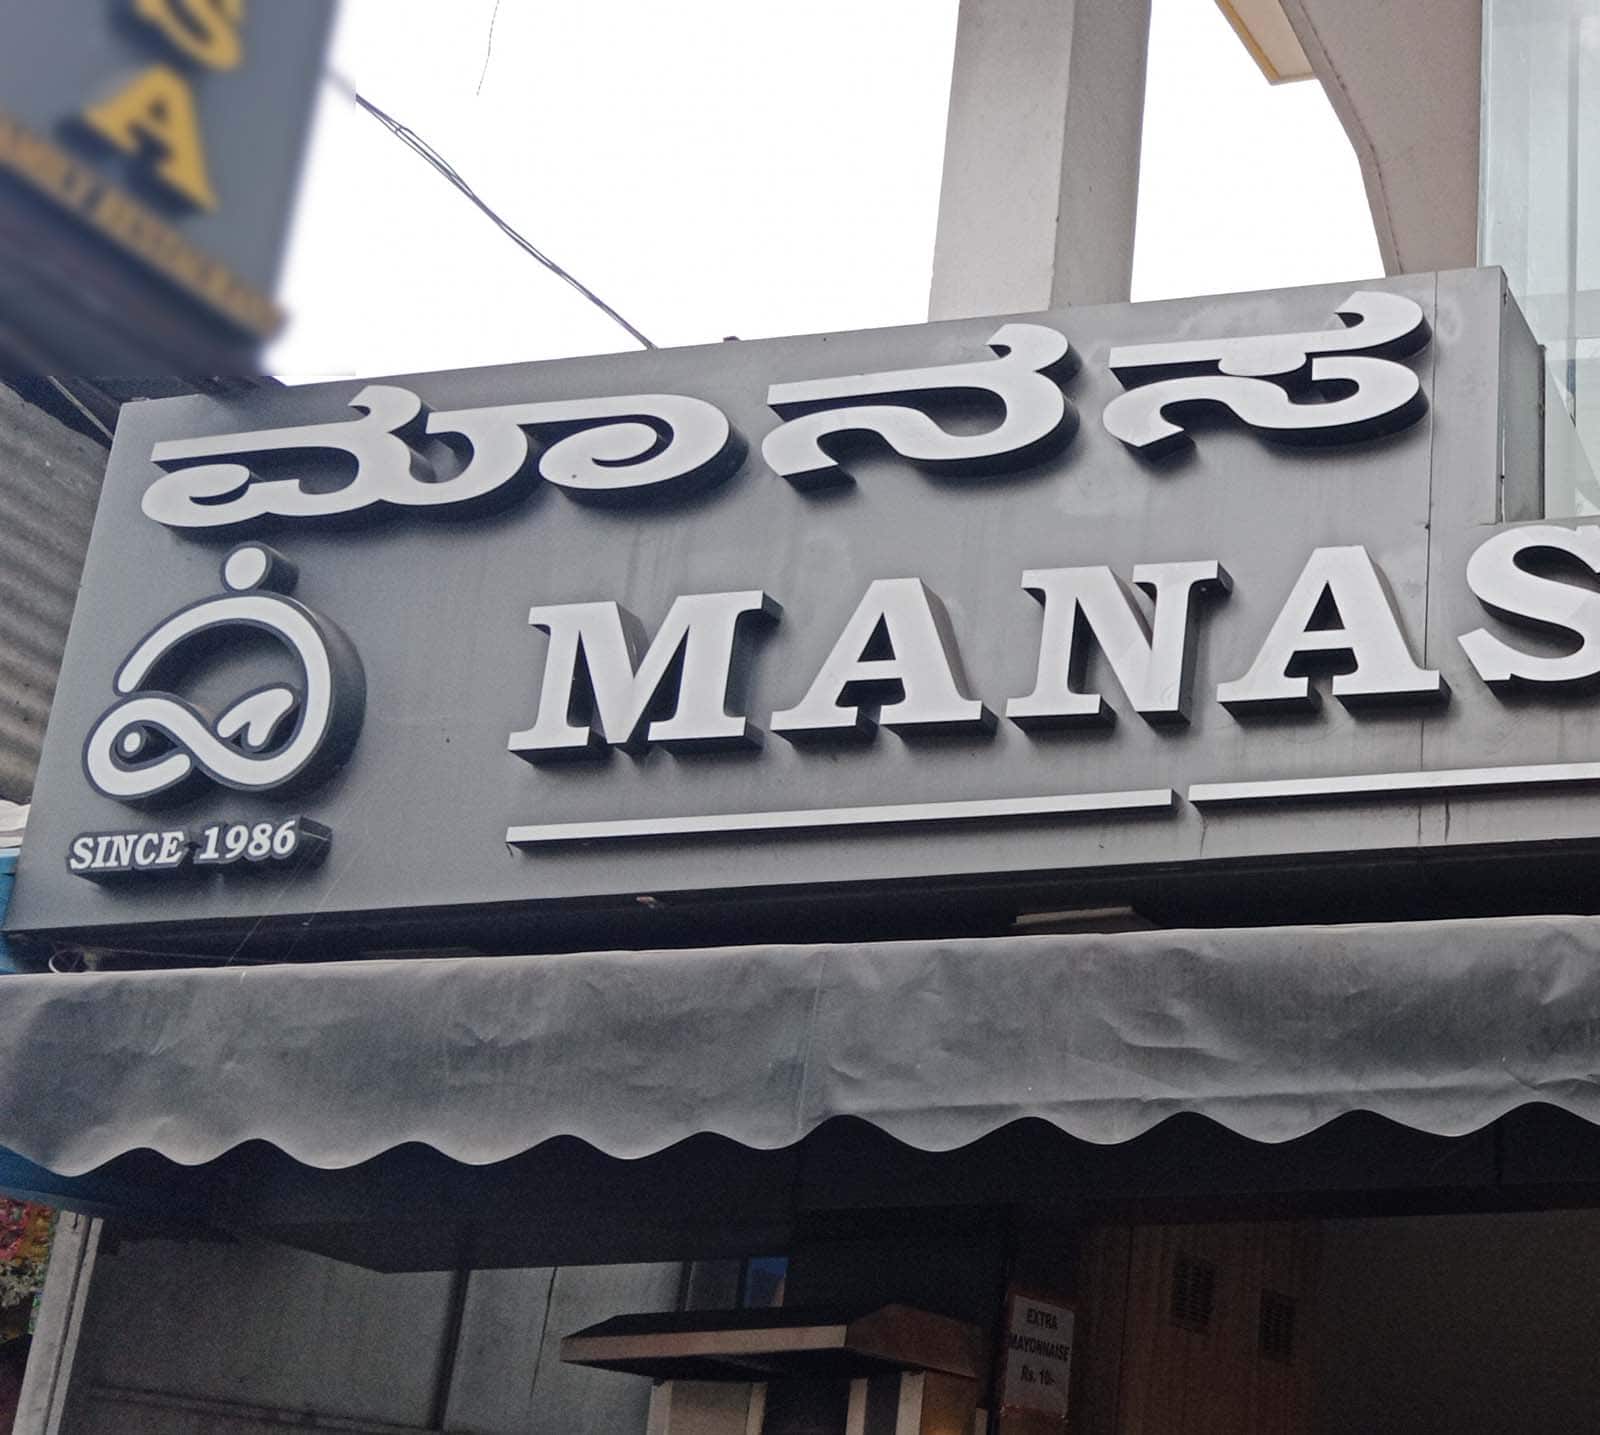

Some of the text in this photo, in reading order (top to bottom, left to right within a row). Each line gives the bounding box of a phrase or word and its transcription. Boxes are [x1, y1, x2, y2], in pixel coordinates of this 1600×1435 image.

[69, 819, 297, 870] SINCE 1986
[1026, 1307, 1058, 1331] EXTRA
[1008, 1332, 1070, 1362] MAYONNAISE
